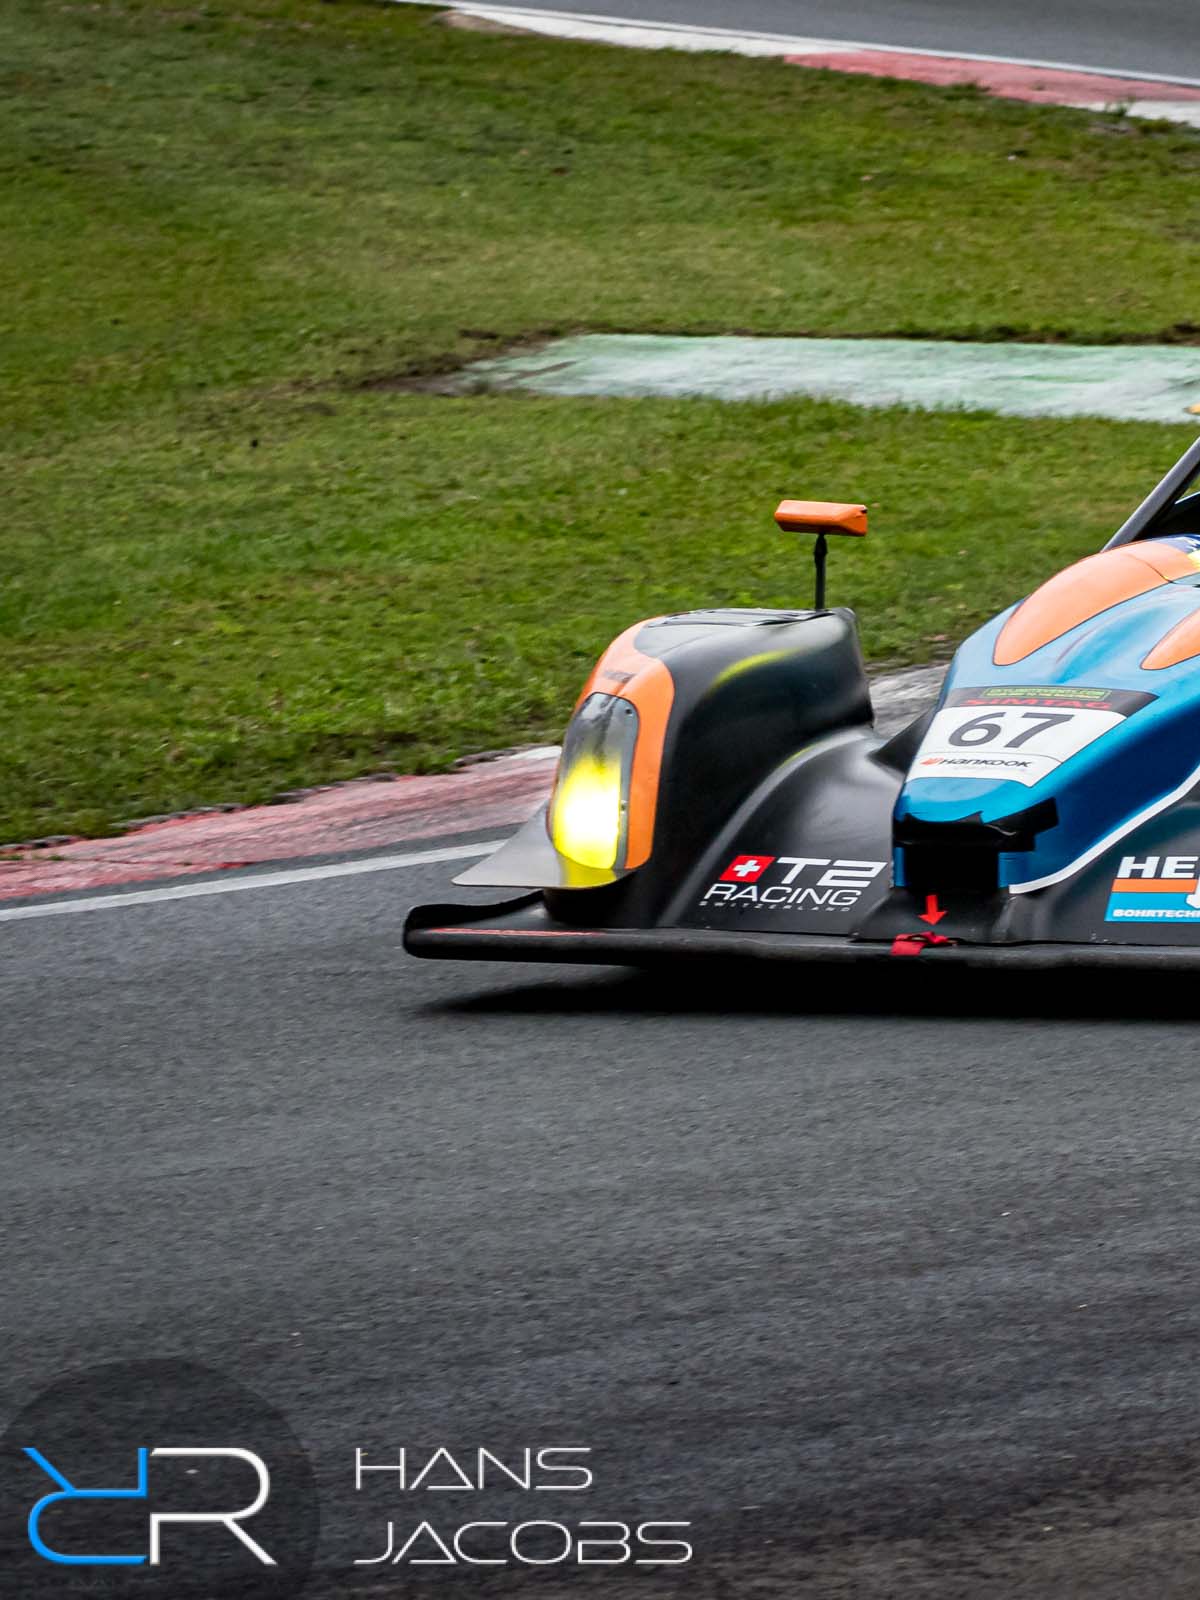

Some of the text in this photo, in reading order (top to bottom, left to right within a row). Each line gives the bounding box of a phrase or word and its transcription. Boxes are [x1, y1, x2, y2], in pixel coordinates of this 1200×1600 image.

[948, 711, 1075, 748] 67
[777, 857, 888, 888] T2
[704, 883, 862, 906] RACING
